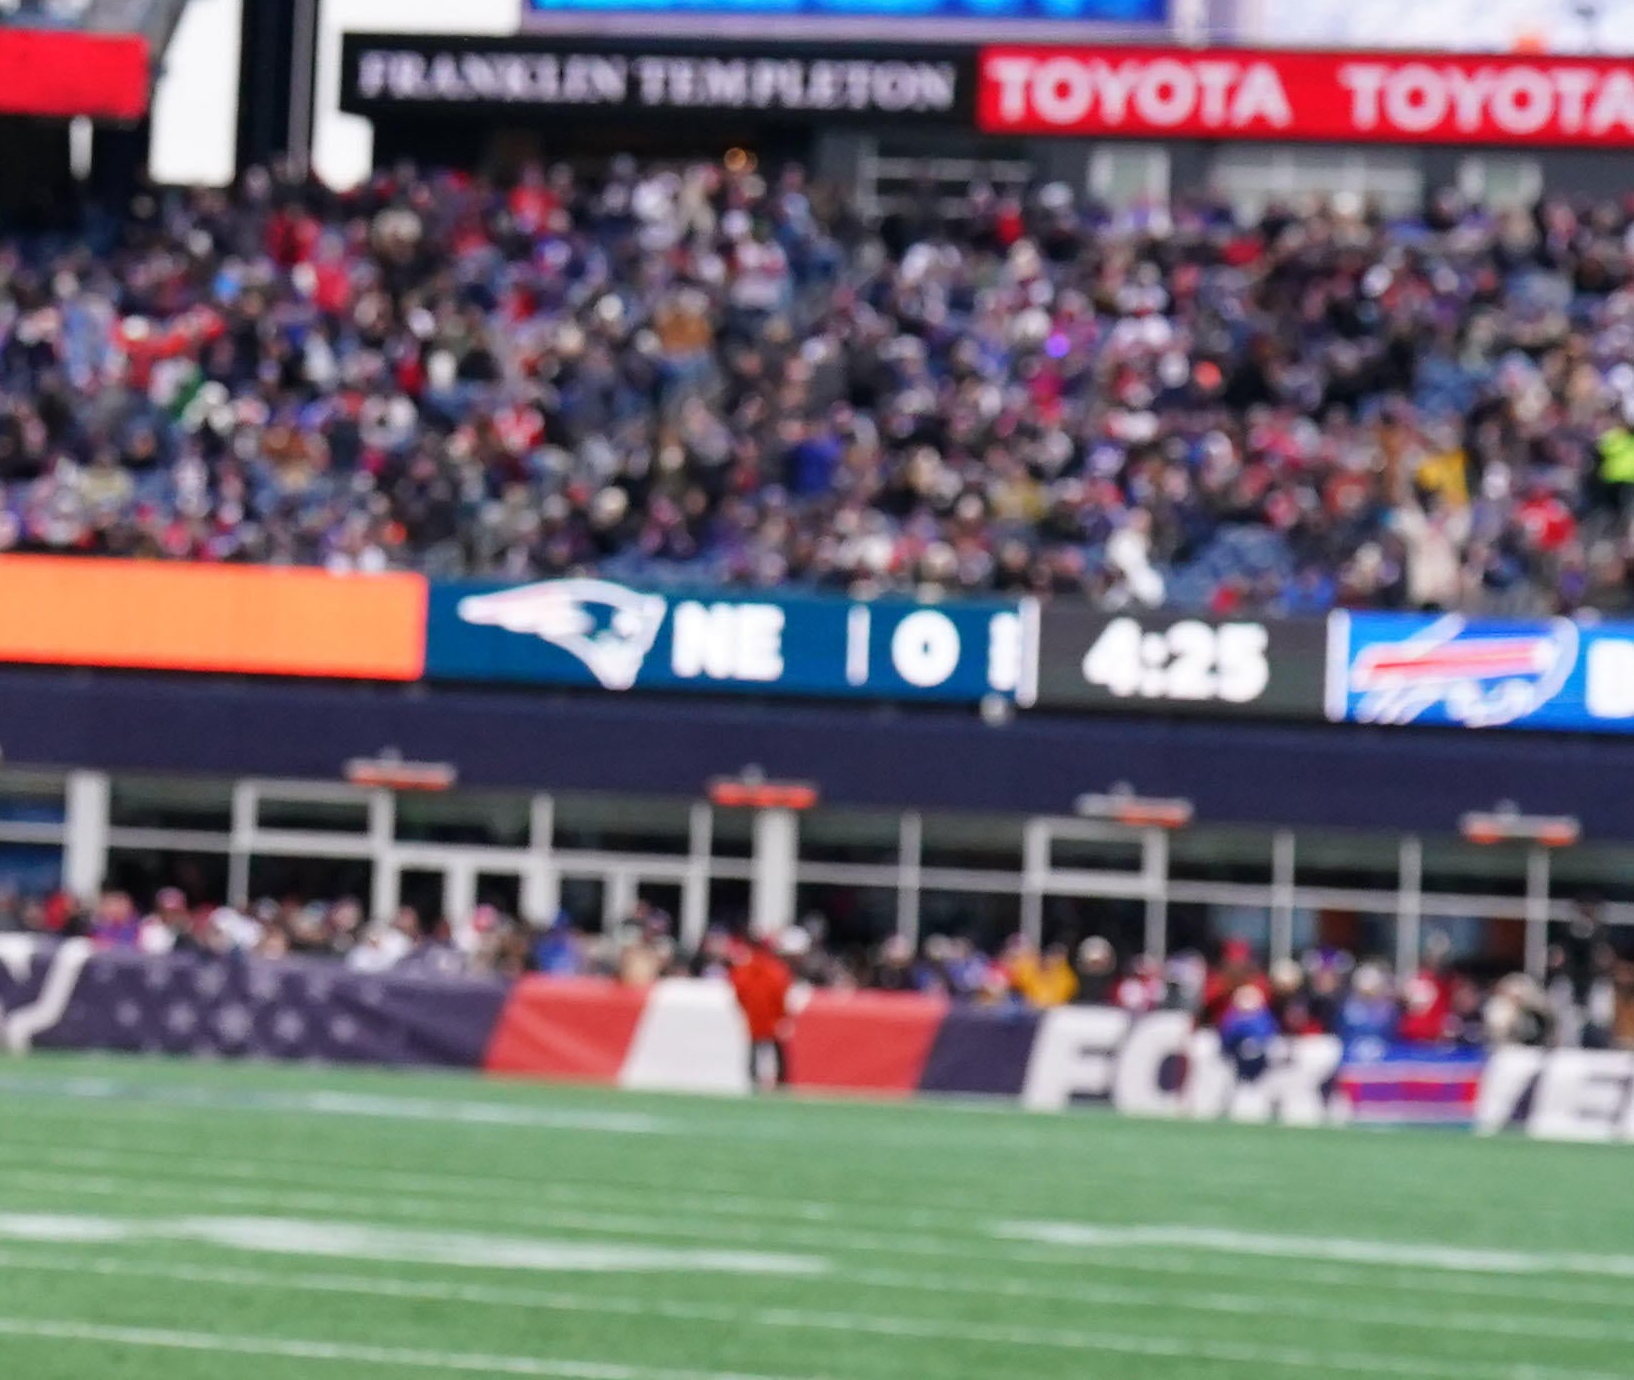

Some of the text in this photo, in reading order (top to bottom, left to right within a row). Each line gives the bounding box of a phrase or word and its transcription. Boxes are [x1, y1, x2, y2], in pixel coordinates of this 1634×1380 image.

[357, 49, 957, 112] FRANKLIN TEMPLETON
[985, 55, 1294, 128] TOYOTA
[672, 599, 961, 688] NE 0
[1082, 618, 1270, 703] 4:25
